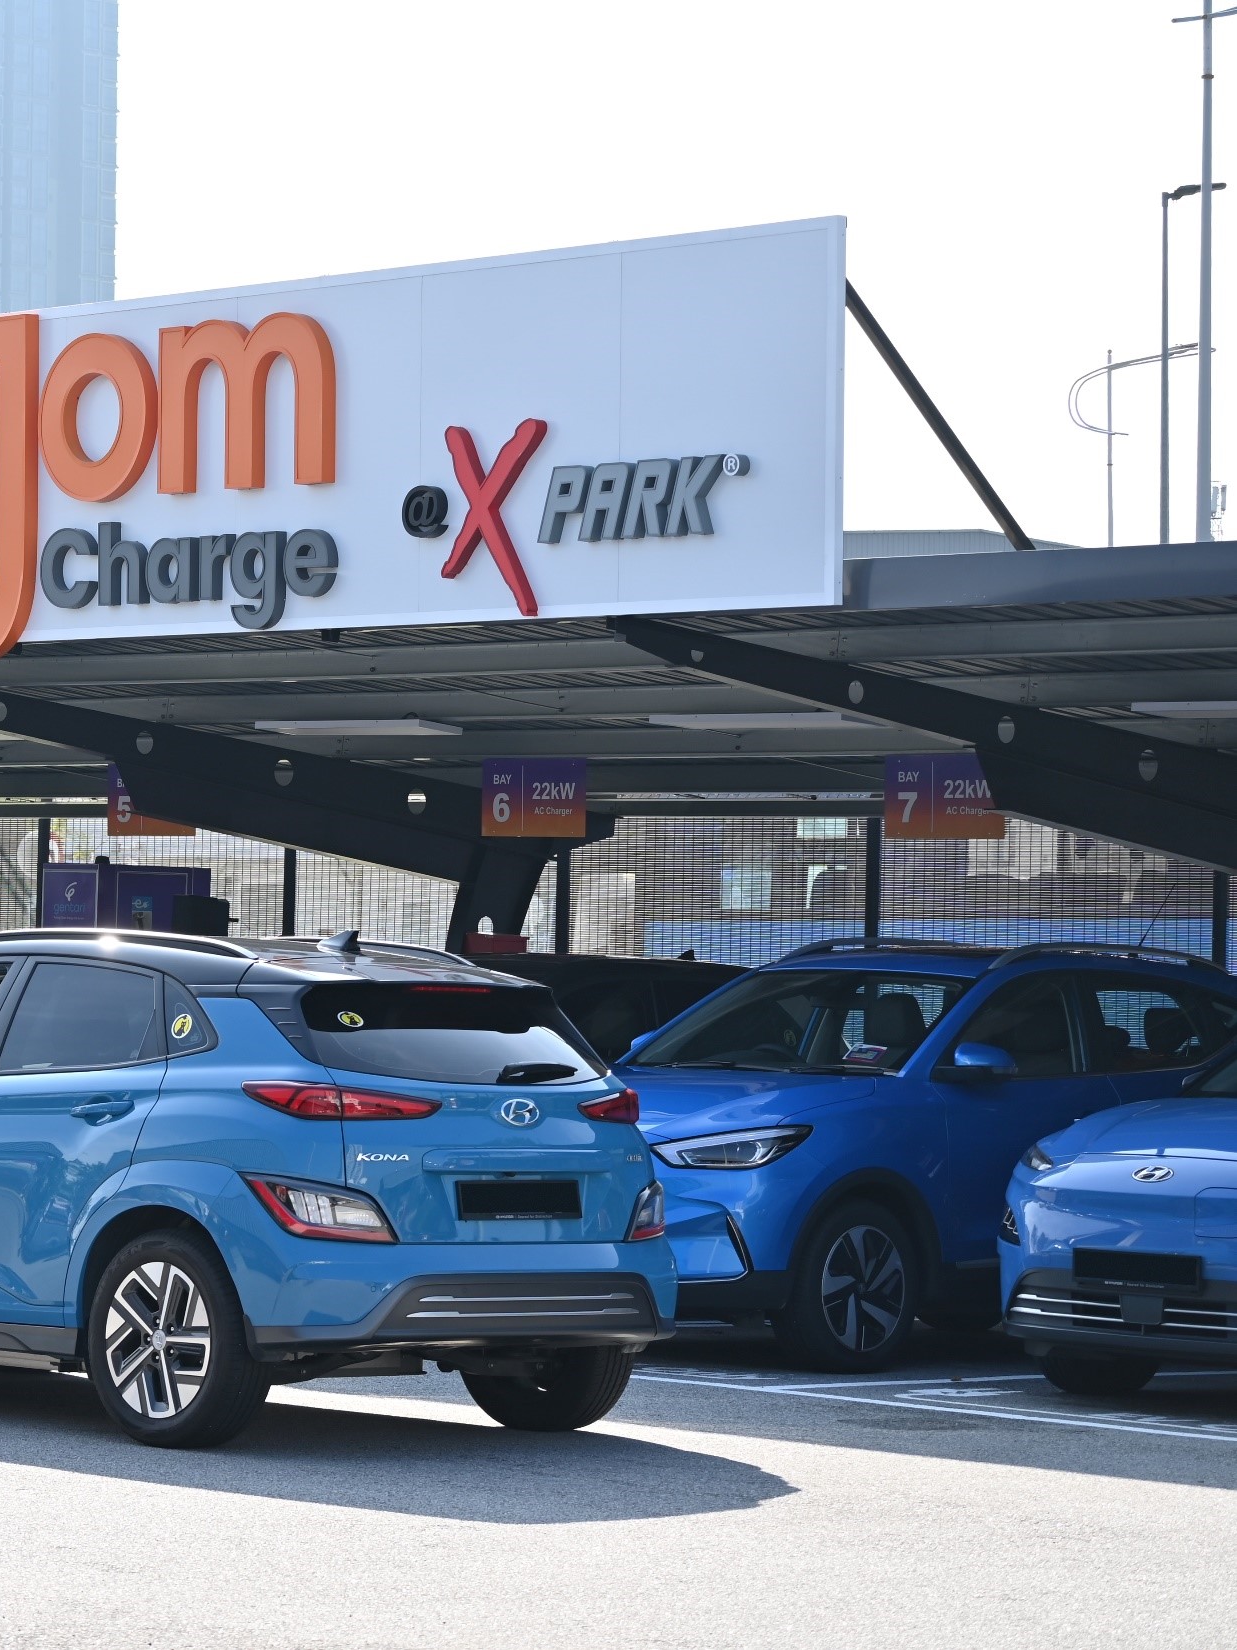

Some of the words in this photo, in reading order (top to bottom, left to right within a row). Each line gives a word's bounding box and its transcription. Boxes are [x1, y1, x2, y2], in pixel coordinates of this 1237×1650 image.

[40, 521, 339, 630] Charge
[493, 774, 512, 785] BAY
[897, 771, 920, 782] BAY
[531, 782, 576, 800] 22kW
[943, 779, 992, 799] 22kW
[116, 795, 132, 823] 5
[492, 792, 511, 823] 6
[534, 806, 545, 815] AC
[545, 806, 573, 817] Charger
[897, 791, 918, 823] 7
[945, 806, 958, 815] AC
[53, 902, 86, 915] gentari
[356, 1152, 410, 1162] KONA
